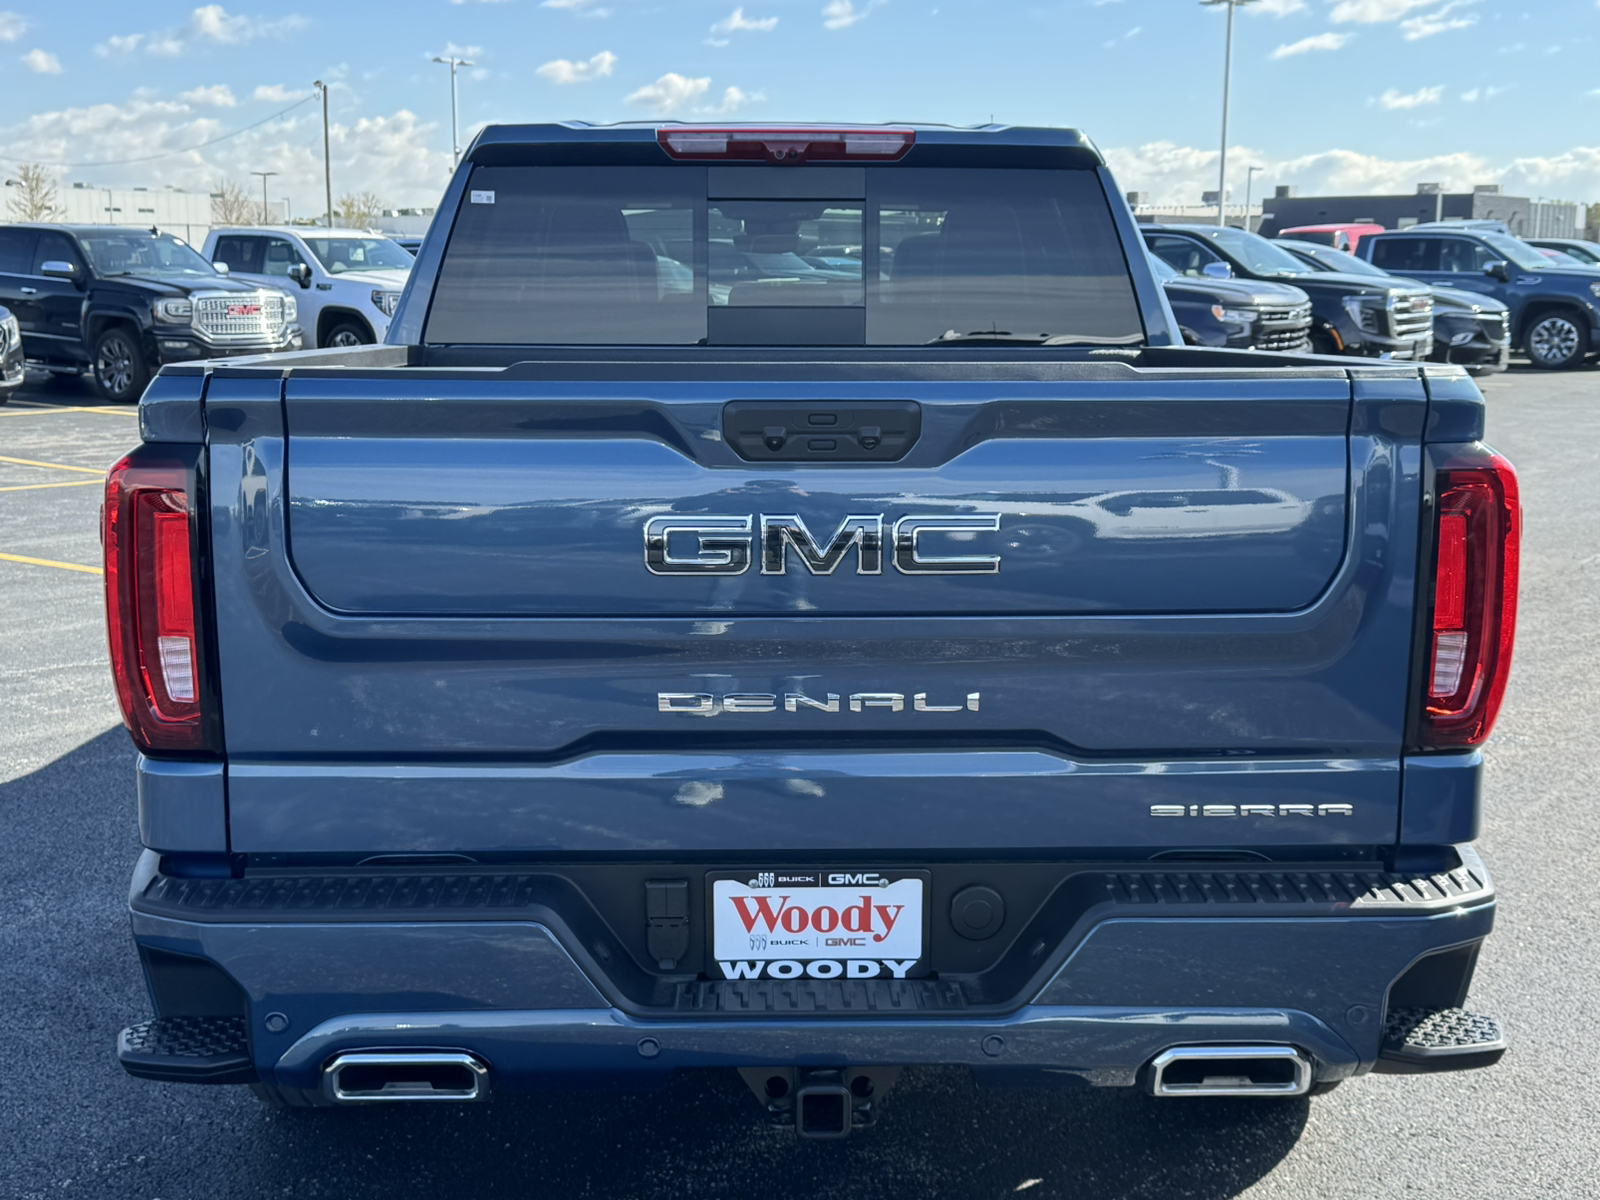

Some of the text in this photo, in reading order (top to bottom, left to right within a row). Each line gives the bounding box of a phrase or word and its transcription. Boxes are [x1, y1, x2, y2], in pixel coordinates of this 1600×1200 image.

[643, 512, 1002, 575] GMC
[657, 692, 980, 713] DENALI
[1150, 803, 1354, 817] SIERRA
[828, 873, 880, 885] GMC
[728, 895, 905, 943] Woody
[825, 937, 866, 947] GMC
[718, 959, 918, 979] WOODY
